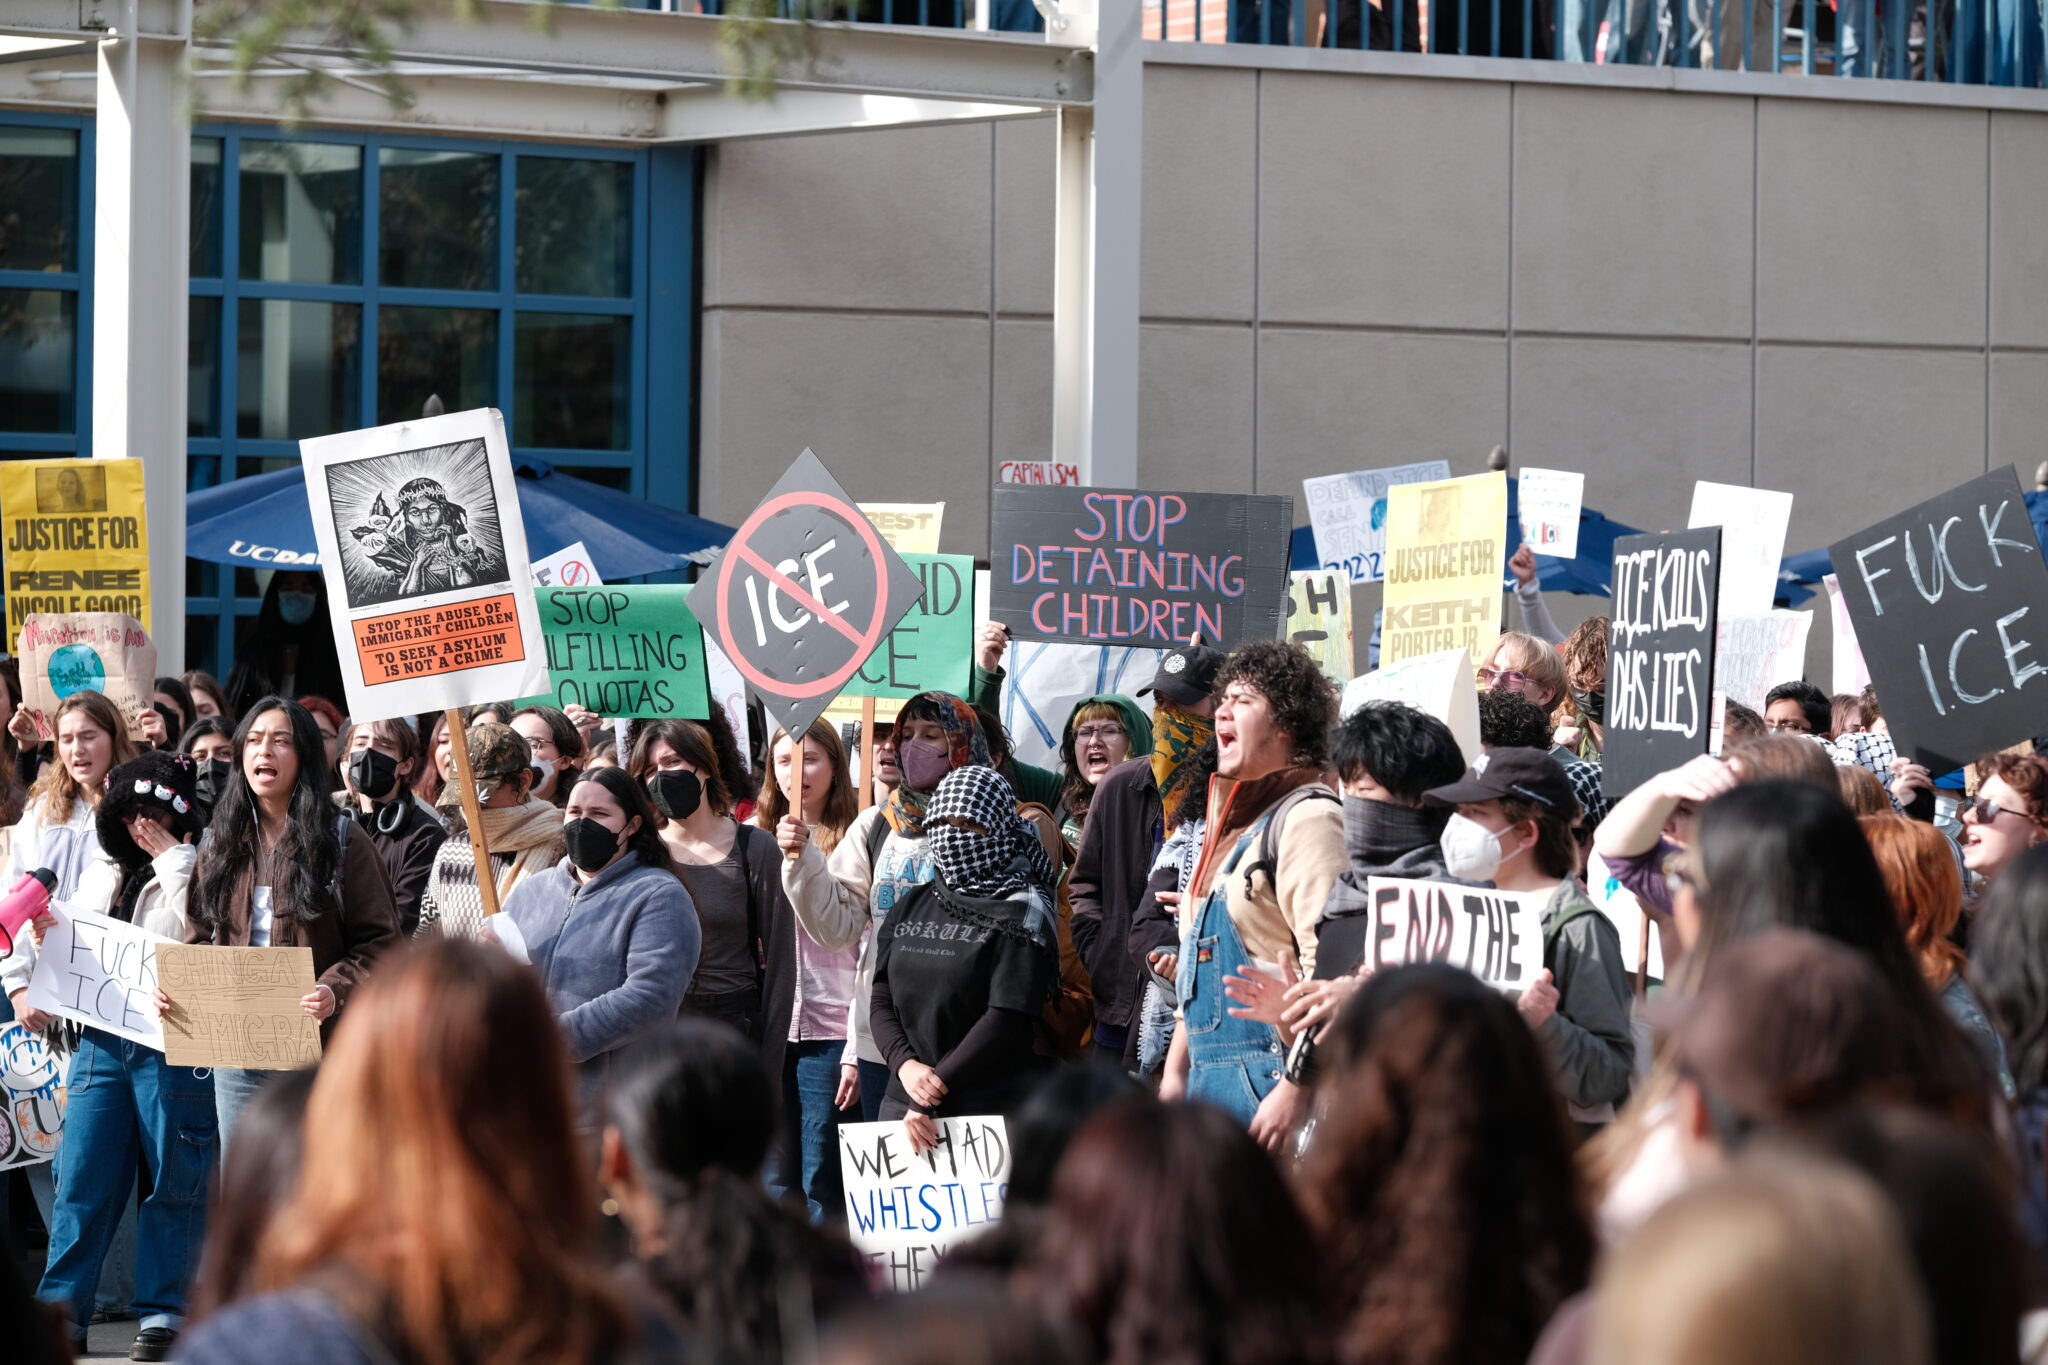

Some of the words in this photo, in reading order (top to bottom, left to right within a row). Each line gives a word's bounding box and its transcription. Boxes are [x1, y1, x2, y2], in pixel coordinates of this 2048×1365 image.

[9, 517, 95, 551] JUSTICE
[97, 515, 139, 549] FOR
[1074, 492, 1187, 545] STOP
[10, 568, 141, 591] RENEE
[1011, 543, 1246, 598] DETAINING
[1389, 541, 1457, 585] JUSTICE
[1460, 538, 1496, 576] FOR
[1855, 500, 2034, 616] FUCK
[550, 590, 630, 627] STOP
[744, 538, 850, 647] ICE
[1031, 592, 1223, 642] CHILDREN
[1385, 596, 1491, 631] KEITH
[1612, 549, 1656, 645] ICE
[1653, 548, 1710, 632] KILLS
[360, 624, 441, 648] IMMIGRANT
[445, 611, 514, 633] CHILDREN
[368, 618, 401, 635] STOP
[405, 613, 432, 628] THE
[436, 604, 481, 623] ABUSE
[484, 602, 502, 615] OF
[375, 651, 395, 666] TO
[400, 645, 438, 662] SEEK
[443, 632, 507, 655] ASYLUM
[384, 663, 400, 678] IS
[403, 658, 433, 675] NOT
[438, 656, 450, 669] A
[454, 646, 504, 666] CRIME
[558, 678, 675, 715] QUOTAS
[1610, 650, 1648, 731] DHS
[1651, 648, 1702, 739] LIES
[71, 919, 156, 987] FUCK
[1375, 886, 1454, 966] END
[1463, 894, 1522, 981] THE
[161, 947, 298, 988] CHINGA
[60, 971, 148, 1034] ICE
[167, 993, 208, 1036] LA
[207, 1012, 322, 1064] MIGRA
[925, 1121, 1005, 1181] HAD
